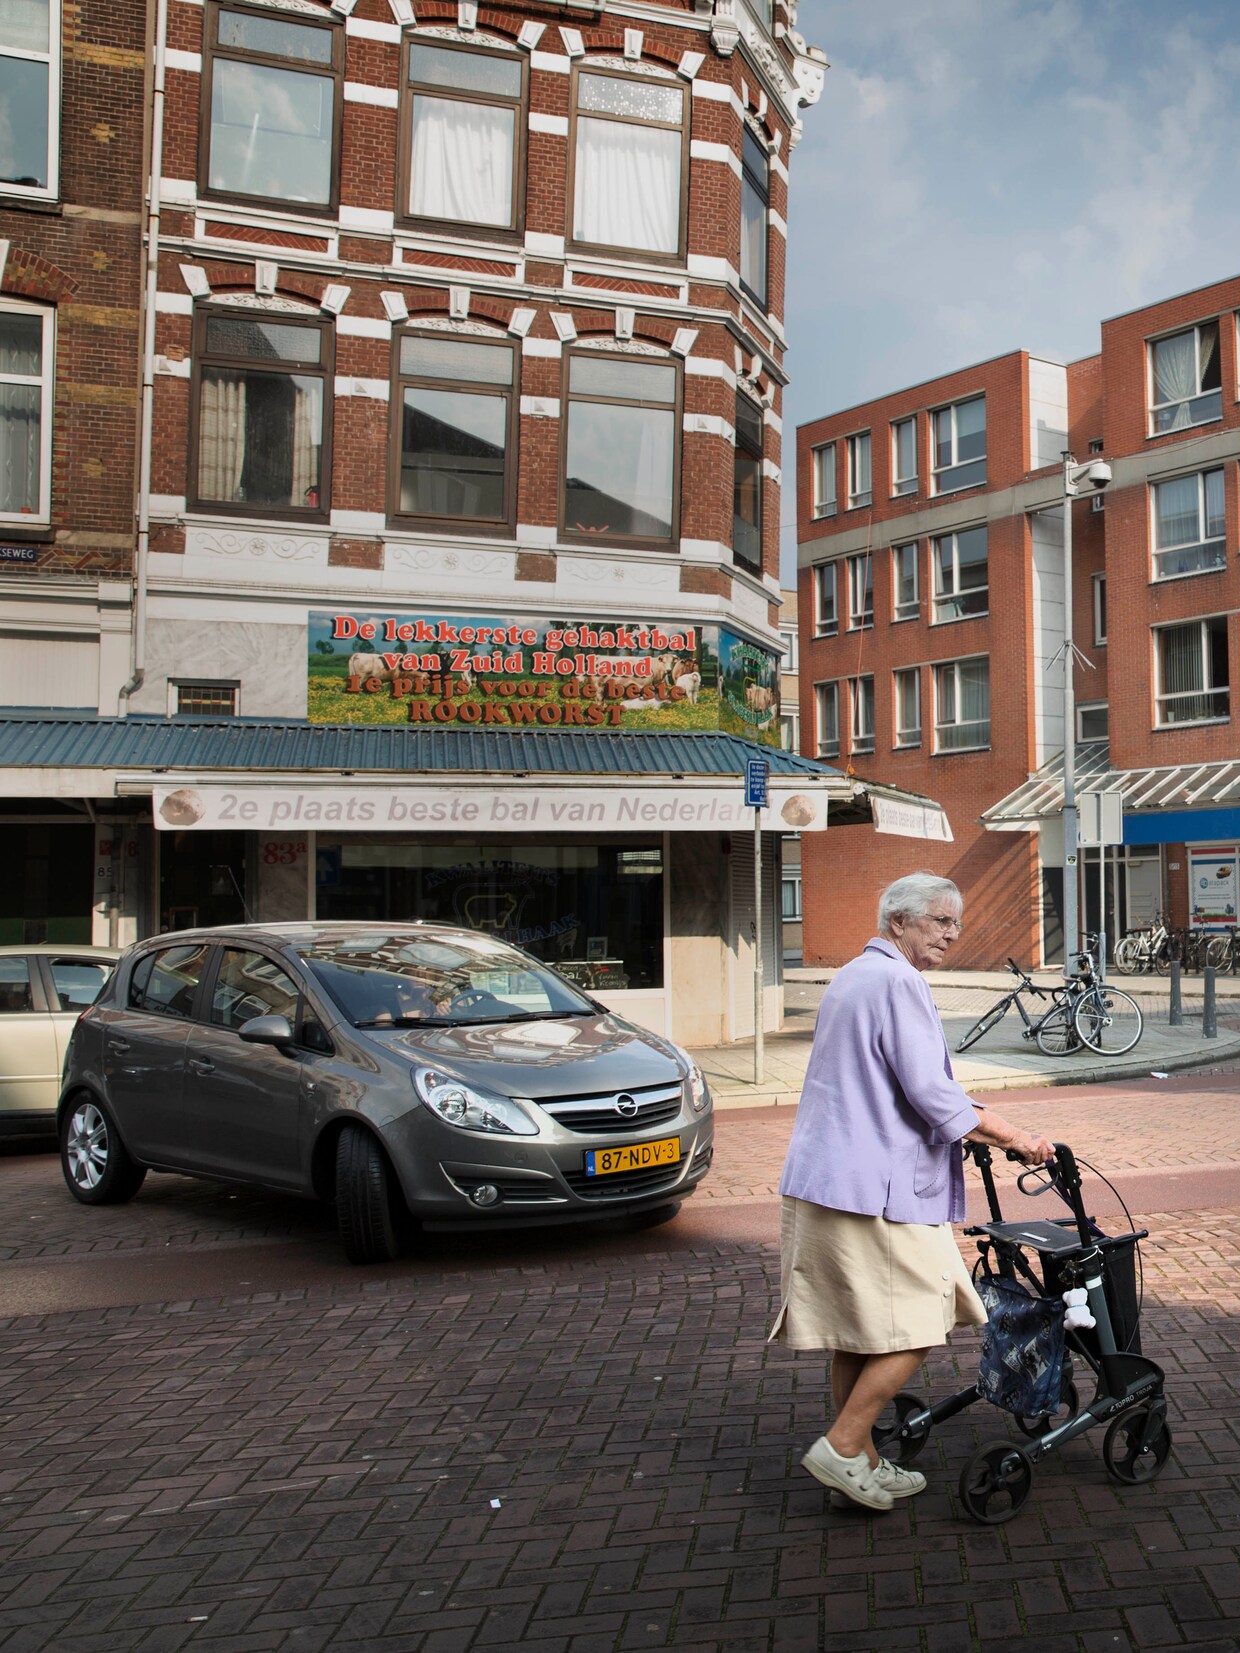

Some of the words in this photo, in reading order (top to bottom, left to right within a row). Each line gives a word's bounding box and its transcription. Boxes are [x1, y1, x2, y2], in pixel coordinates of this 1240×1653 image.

[0, 548, 34, 559] SEWEG
[333, 615, 376, 639] De
[385, 618, 537, 644] lekkerste
[546, 626, 696, 651] gehaktbal
[383, 652, 441, 671] van
[450, 649, 523, 673] Zuid
[532, 652, 653, 677] Holland
[392, 673, 470, 699] prijs
[481, 680, 553, 697] voor
[562, 678, 597, 698] de
[607, 679, 686, 700] beste
[410, 699, 627, 726] ROOKWORST
[218, 794, 258, 821] 2e
[269, 795, 376, 826] plaats
[387, 796, 478, 821] beste
[490, 796, 537, 821] bal
[551, 801, 604, 821] van
[263, 842, 307, 865] 83a
[517, 913, 581, 945] HAAK
[601, 1142, 674, 1171] 87-NDV-3
[1115, 1394, 1135, 1409] TOPRO
